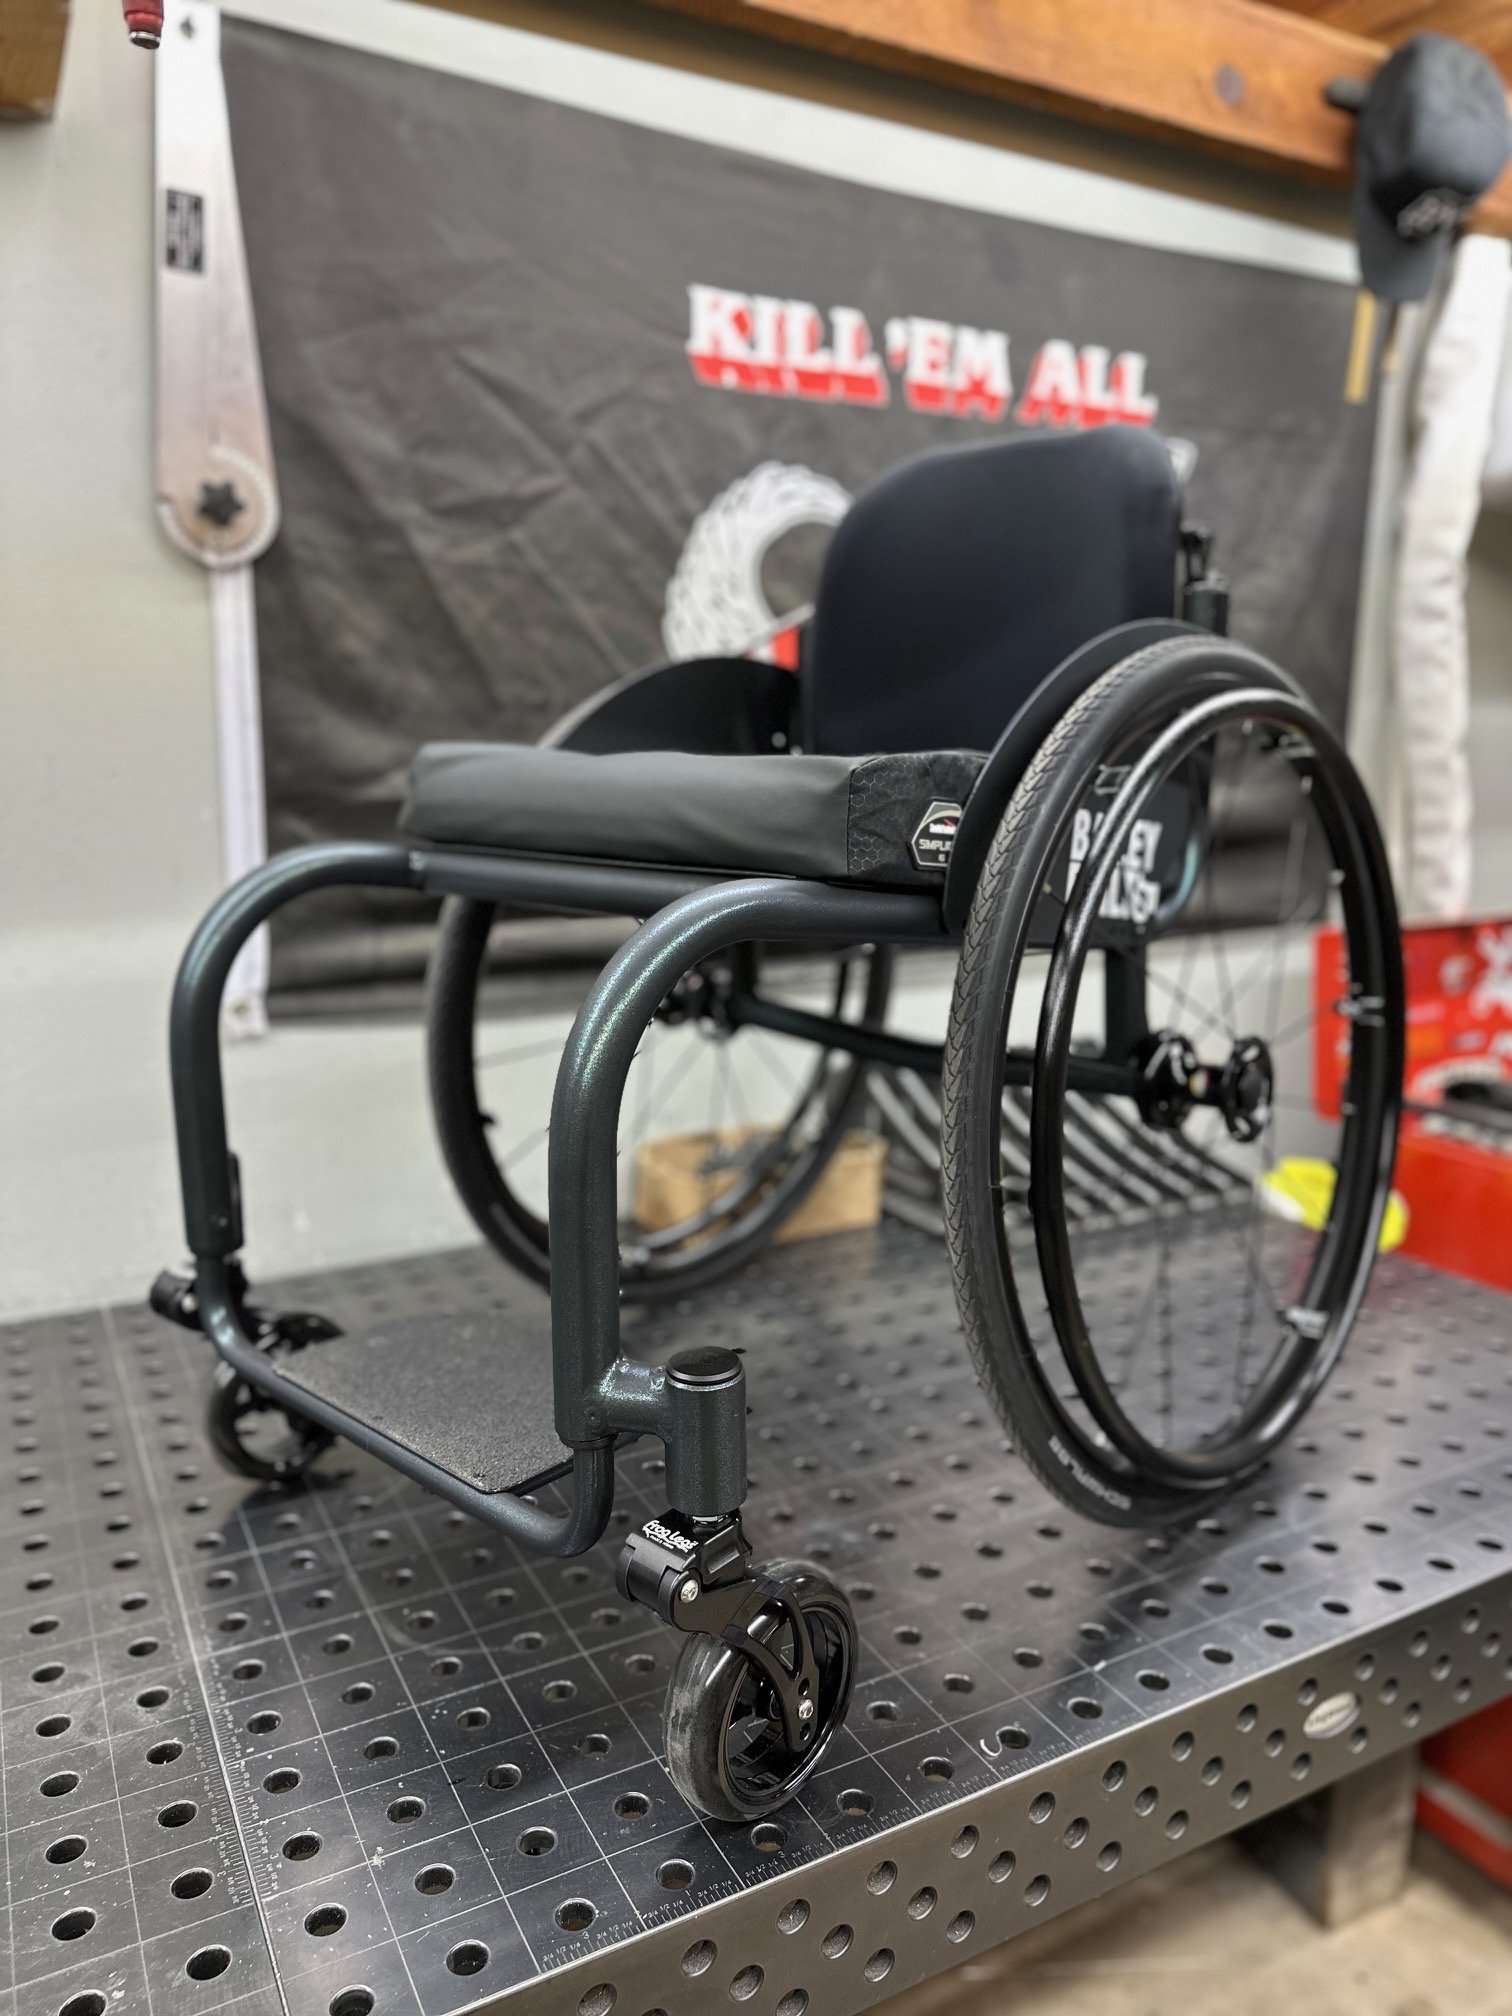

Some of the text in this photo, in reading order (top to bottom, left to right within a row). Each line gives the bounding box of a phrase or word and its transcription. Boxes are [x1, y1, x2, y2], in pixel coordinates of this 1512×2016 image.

[686, 282, 1159, 430] KILL 'EM ALL
[582, 1931, 590, 1939] 3
